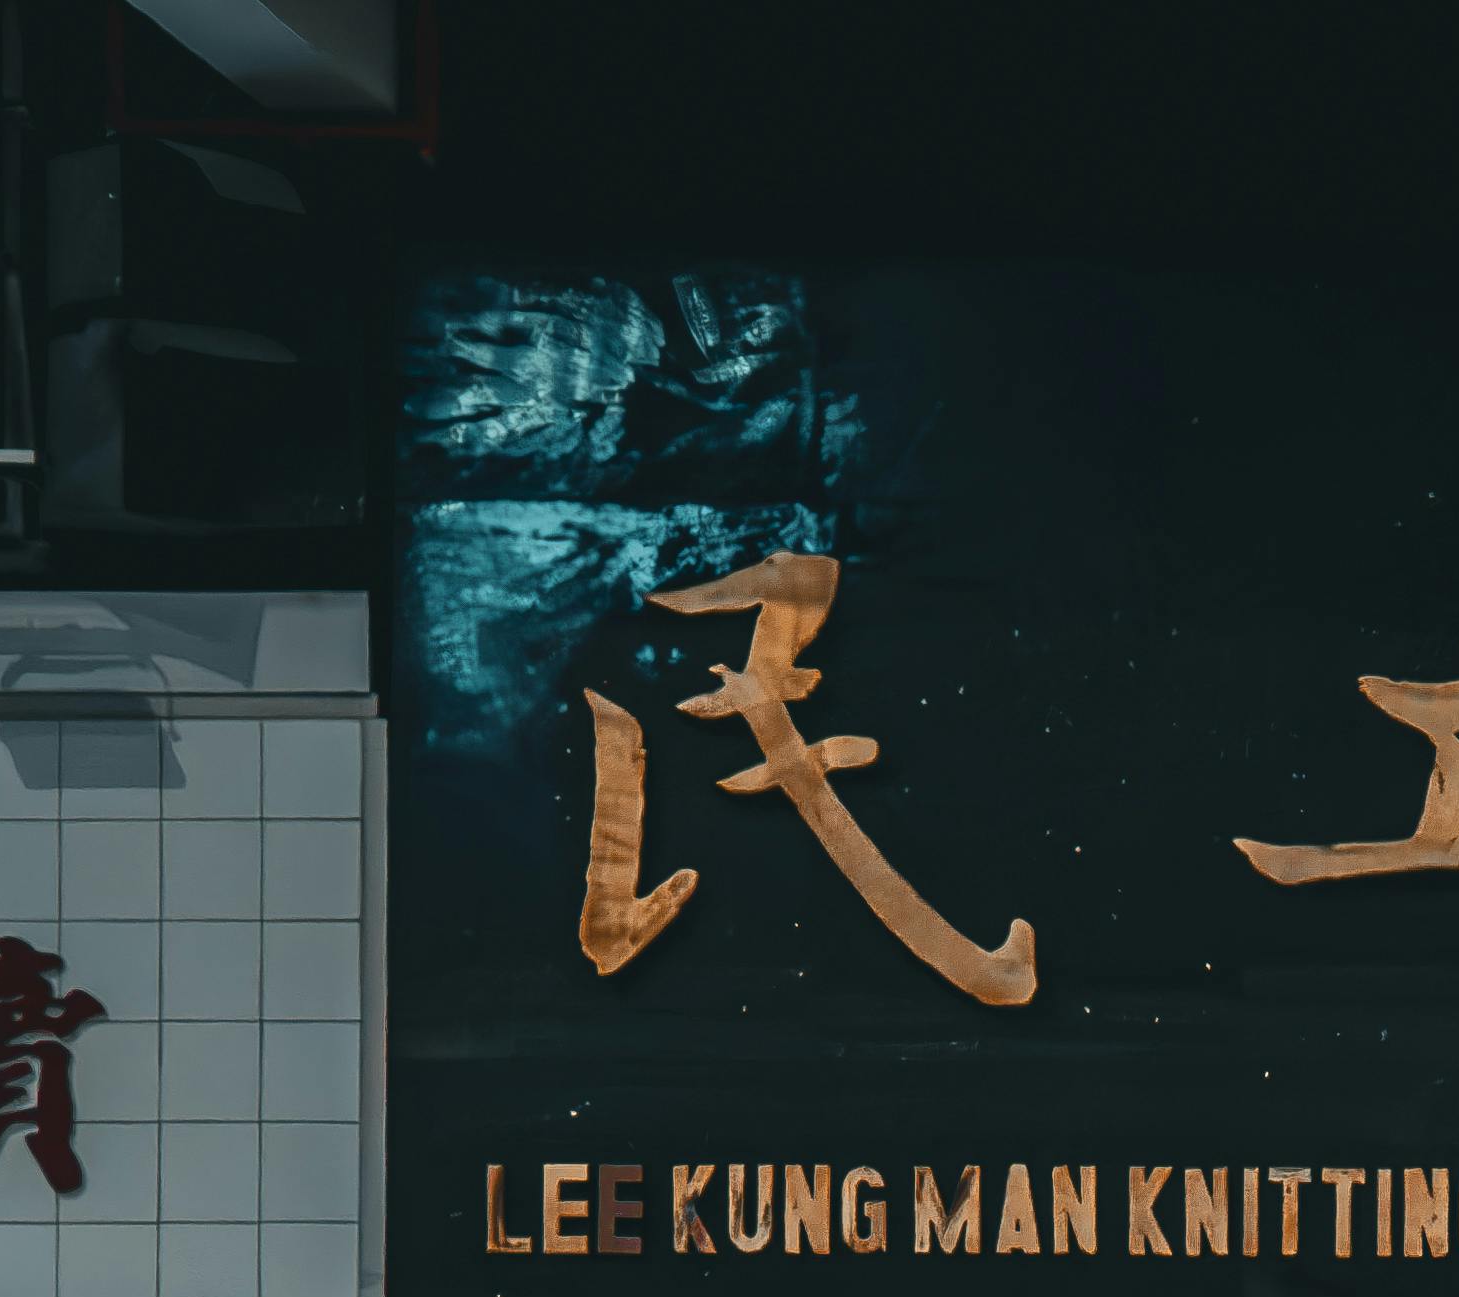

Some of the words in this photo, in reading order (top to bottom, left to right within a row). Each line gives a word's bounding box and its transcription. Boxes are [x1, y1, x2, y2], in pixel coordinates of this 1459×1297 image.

[485, 1163, 644, 1256] LEE
[672, 1164, 888, 1255] KUNG
[913, 1163, 1098, 1256] MAN
